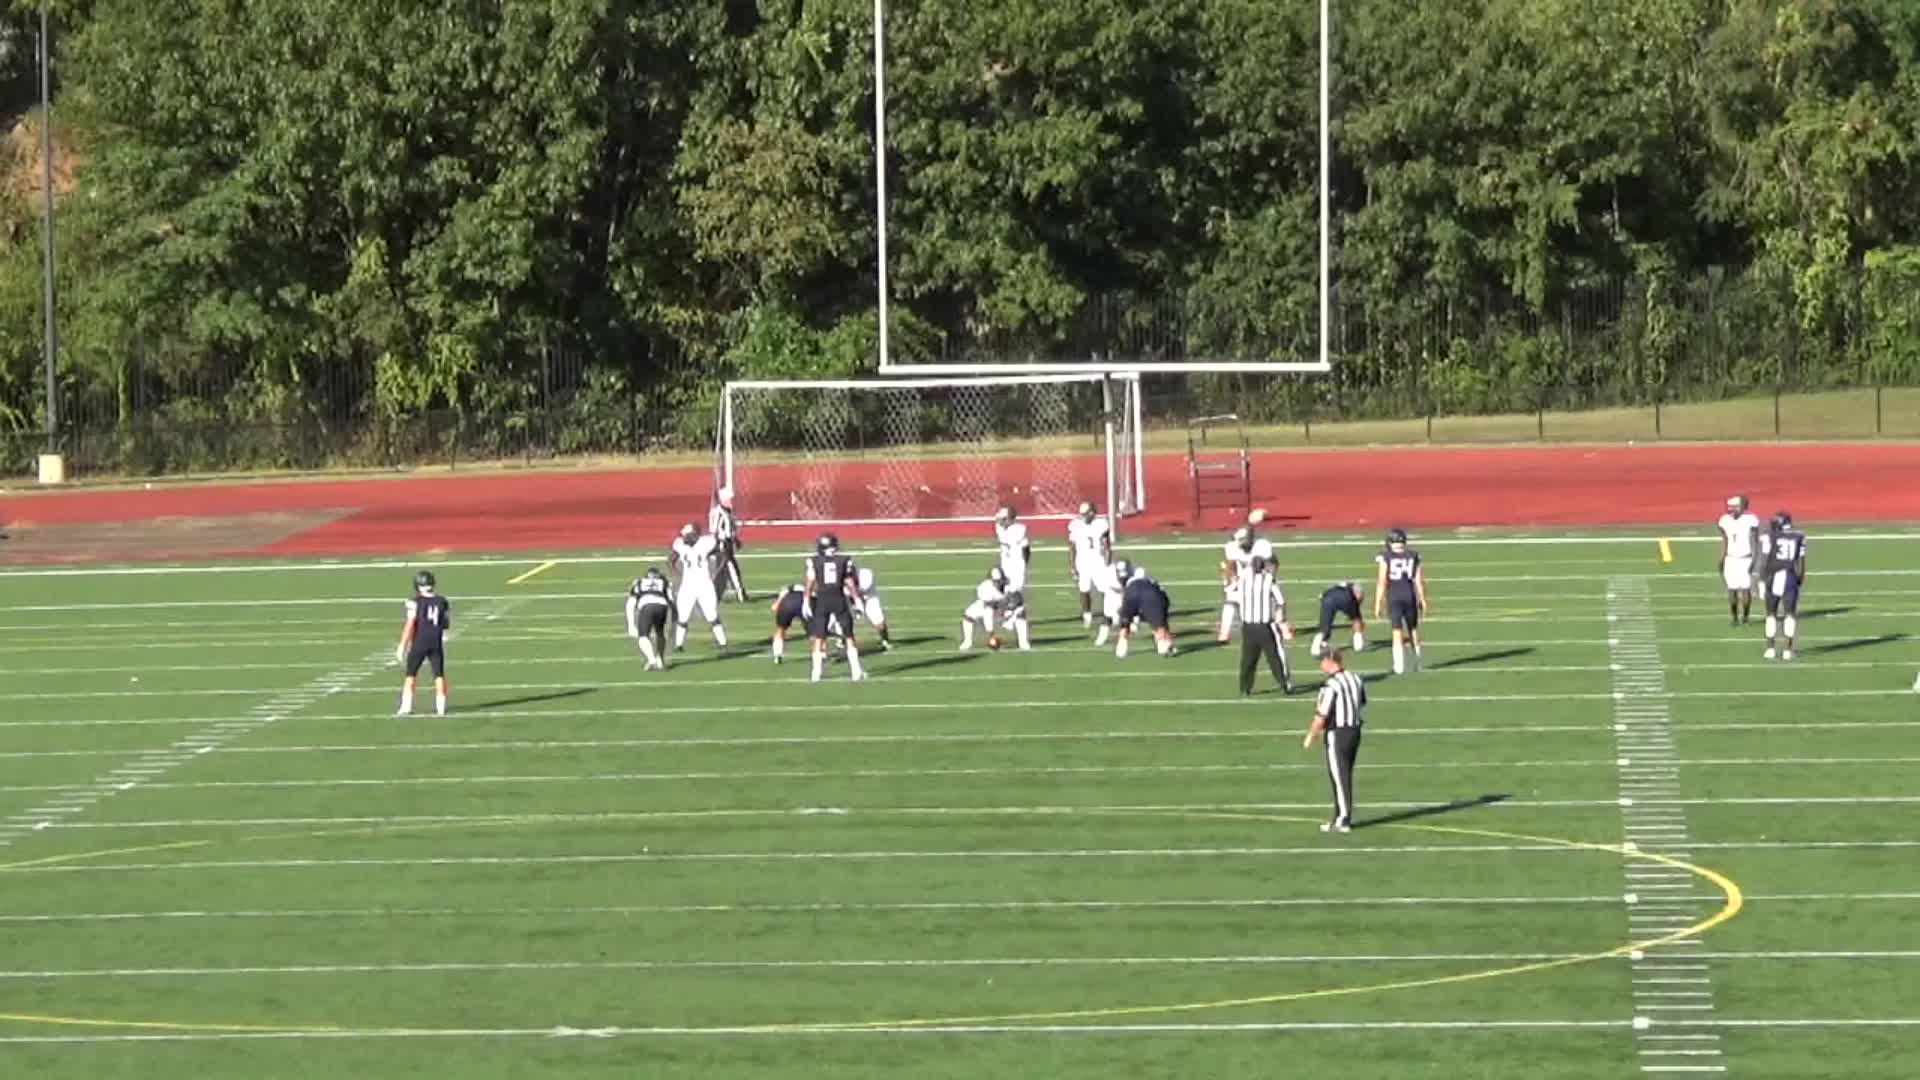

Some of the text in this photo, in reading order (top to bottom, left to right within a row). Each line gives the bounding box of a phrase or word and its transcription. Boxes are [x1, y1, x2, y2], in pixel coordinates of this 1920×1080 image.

[1776, 537, 1797, 561] 31
[1389, 558, 1414, 580] 54
[427, 604, 439, 625] 4
